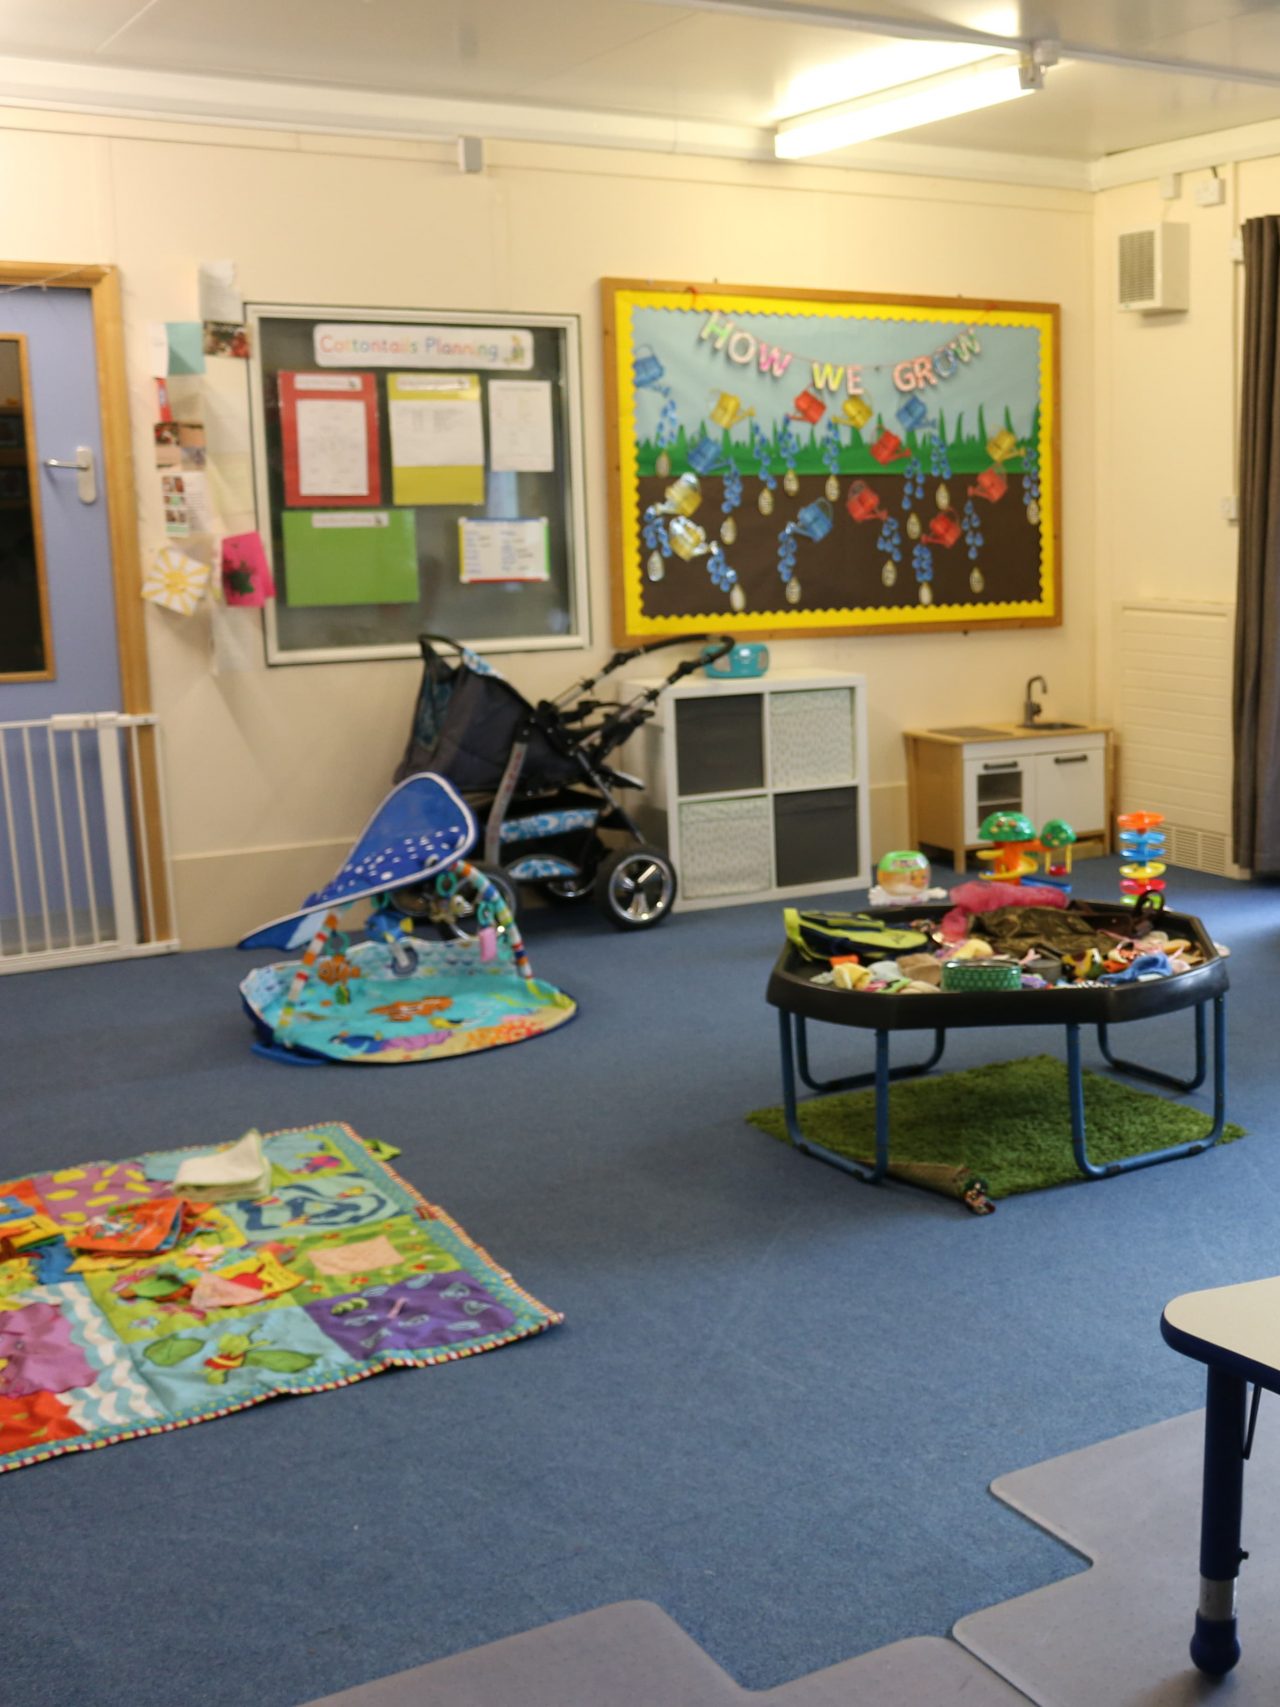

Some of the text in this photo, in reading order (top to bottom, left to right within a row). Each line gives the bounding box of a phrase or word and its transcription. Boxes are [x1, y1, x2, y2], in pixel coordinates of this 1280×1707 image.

[319, 335, 499, 361] Cottontails Planning
[699, 310, 982, 395] HOW WE GROW
